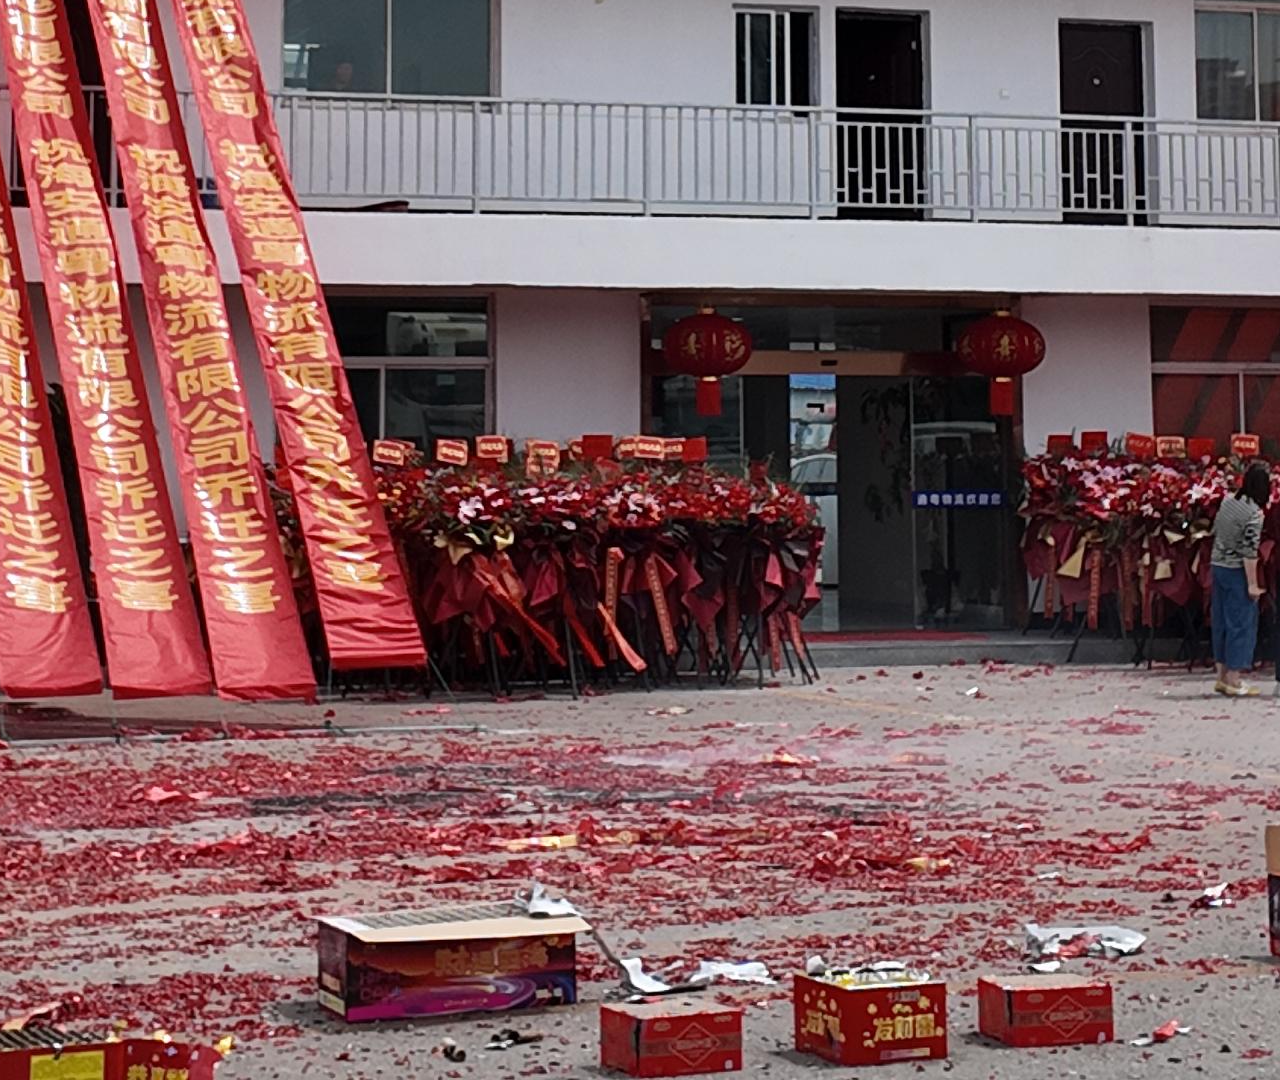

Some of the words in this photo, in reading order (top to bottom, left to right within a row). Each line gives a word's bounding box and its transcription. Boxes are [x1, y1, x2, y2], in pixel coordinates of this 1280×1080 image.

[36, 140, 176, 610] 祝海安通粤物流有限公司乔迁之喜
[131, 147, 278, 613] 祝海安通粤物流有限公司乔迁之喜
[224, 142, 385, 591] 祝海安通粤物流有限公司乔迁之喜
